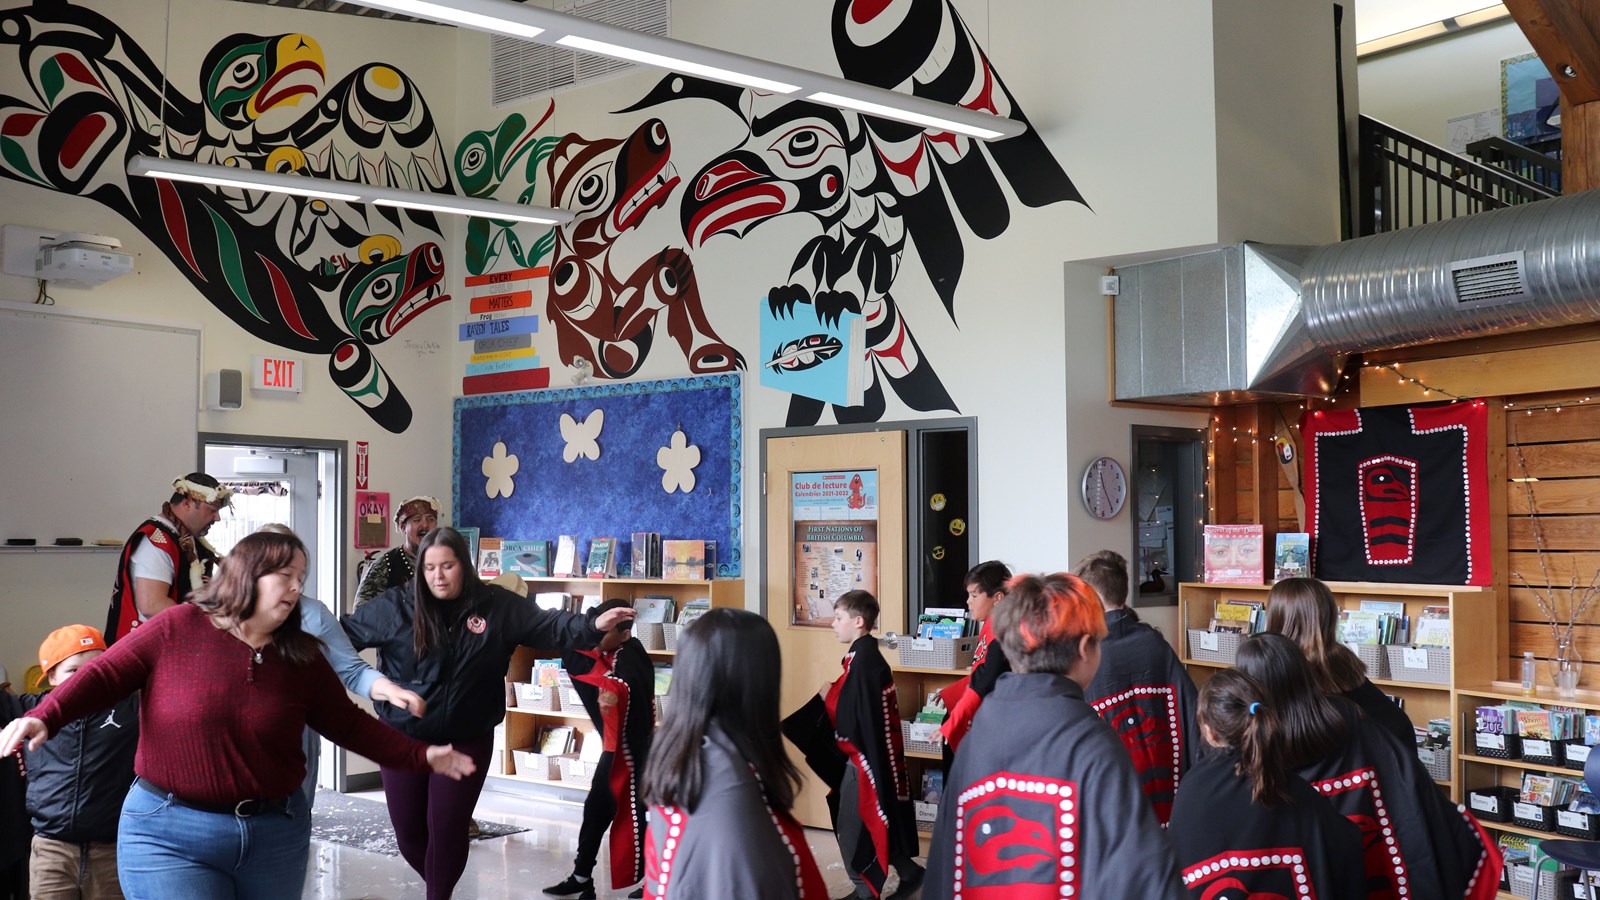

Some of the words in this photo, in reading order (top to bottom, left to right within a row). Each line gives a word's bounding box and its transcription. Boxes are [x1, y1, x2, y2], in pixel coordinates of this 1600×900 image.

[489, 272, 512, 284] EVERY
[488, 296, 514, 309] MATTERS
[480, 313, 492, 321] Frog
[466, 322, 486, 338] RAVEN
[490, 320, 510, 335] TALES
[263, 358, 295, 388] EXIT
[795, 482, 811, 490] Club
[822, 481, 848, 489] lecture
[360, 503, 385, 516] OKAY
[808, 525, 824, 533] FIRST
[826, 525, 853, 533] NATIONS
[853, 525, 863, 533] OF
[831, 533, 864, 541] COLUMBIA
[919, 810, 935, 818] Disney
[1560, 814, 1571, 822] Scary
